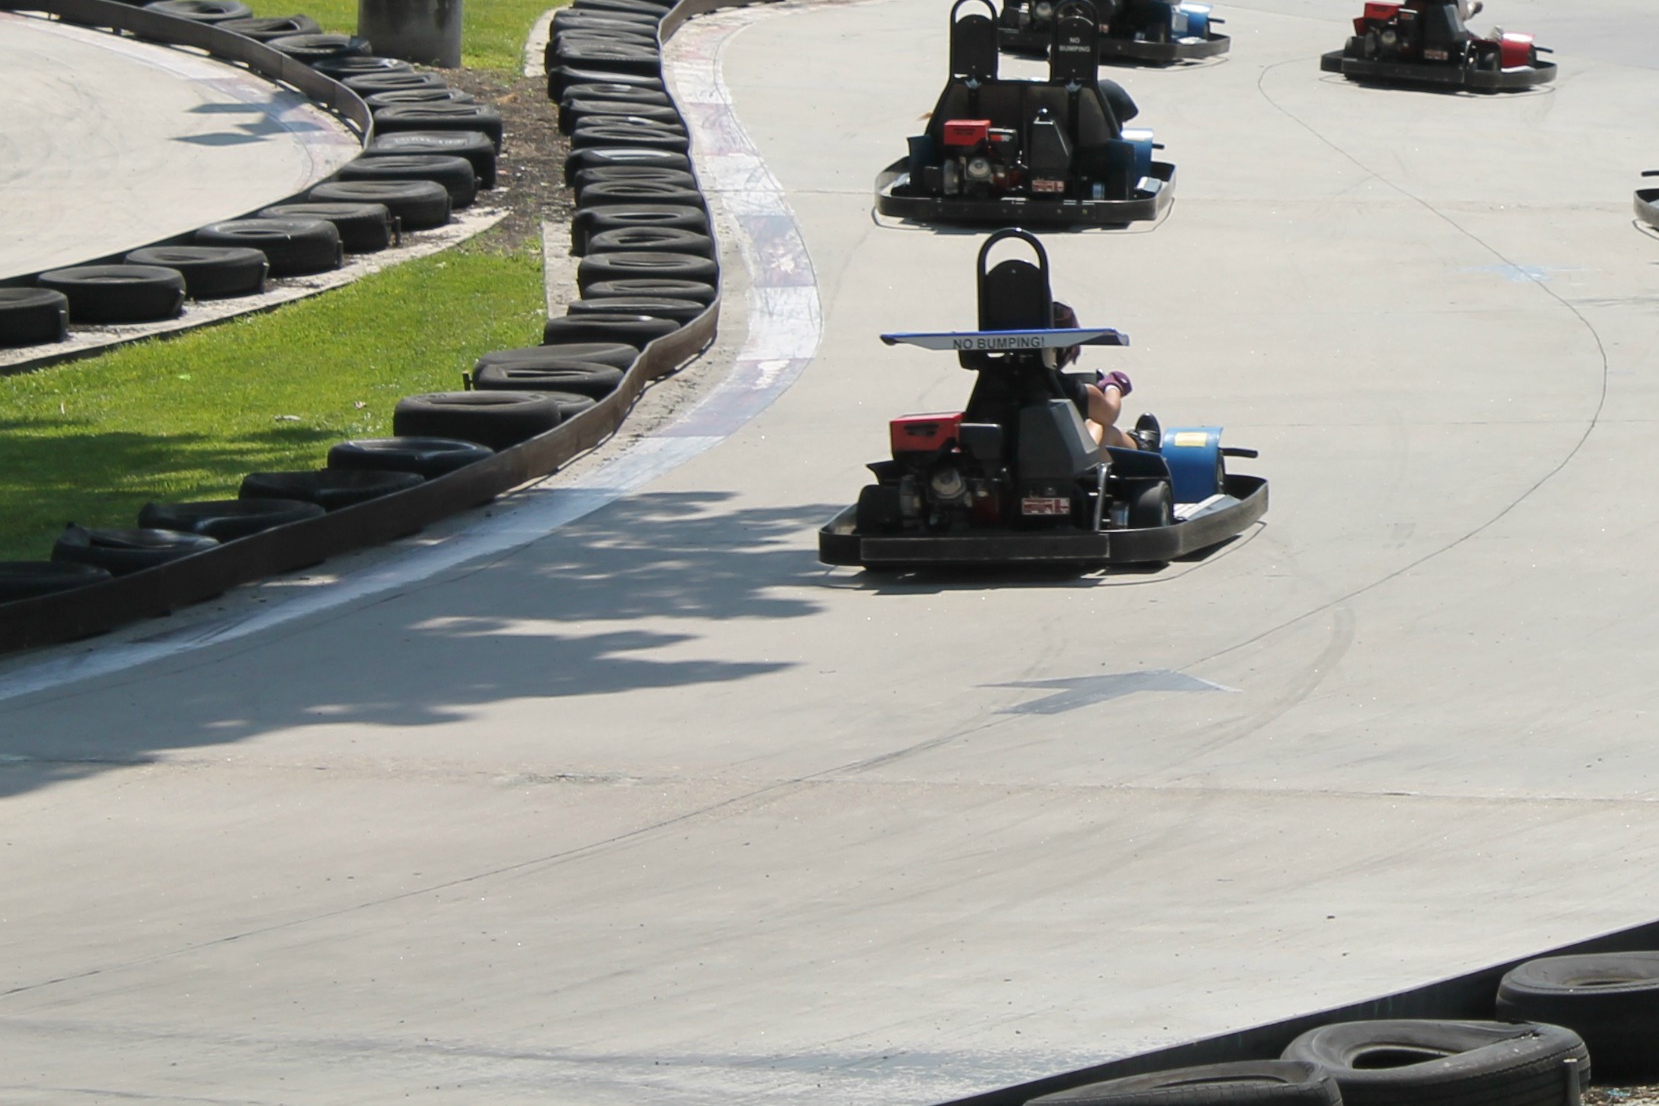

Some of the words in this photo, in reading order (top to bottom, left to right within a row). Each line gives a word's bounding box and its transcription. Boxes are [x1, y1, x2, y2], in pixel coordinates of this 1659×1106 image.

[1059, 45, 1091, 53] BUMPING
[953, 338, 973, 350] NO
[977, 336, 1046, 350] BUMPING!
